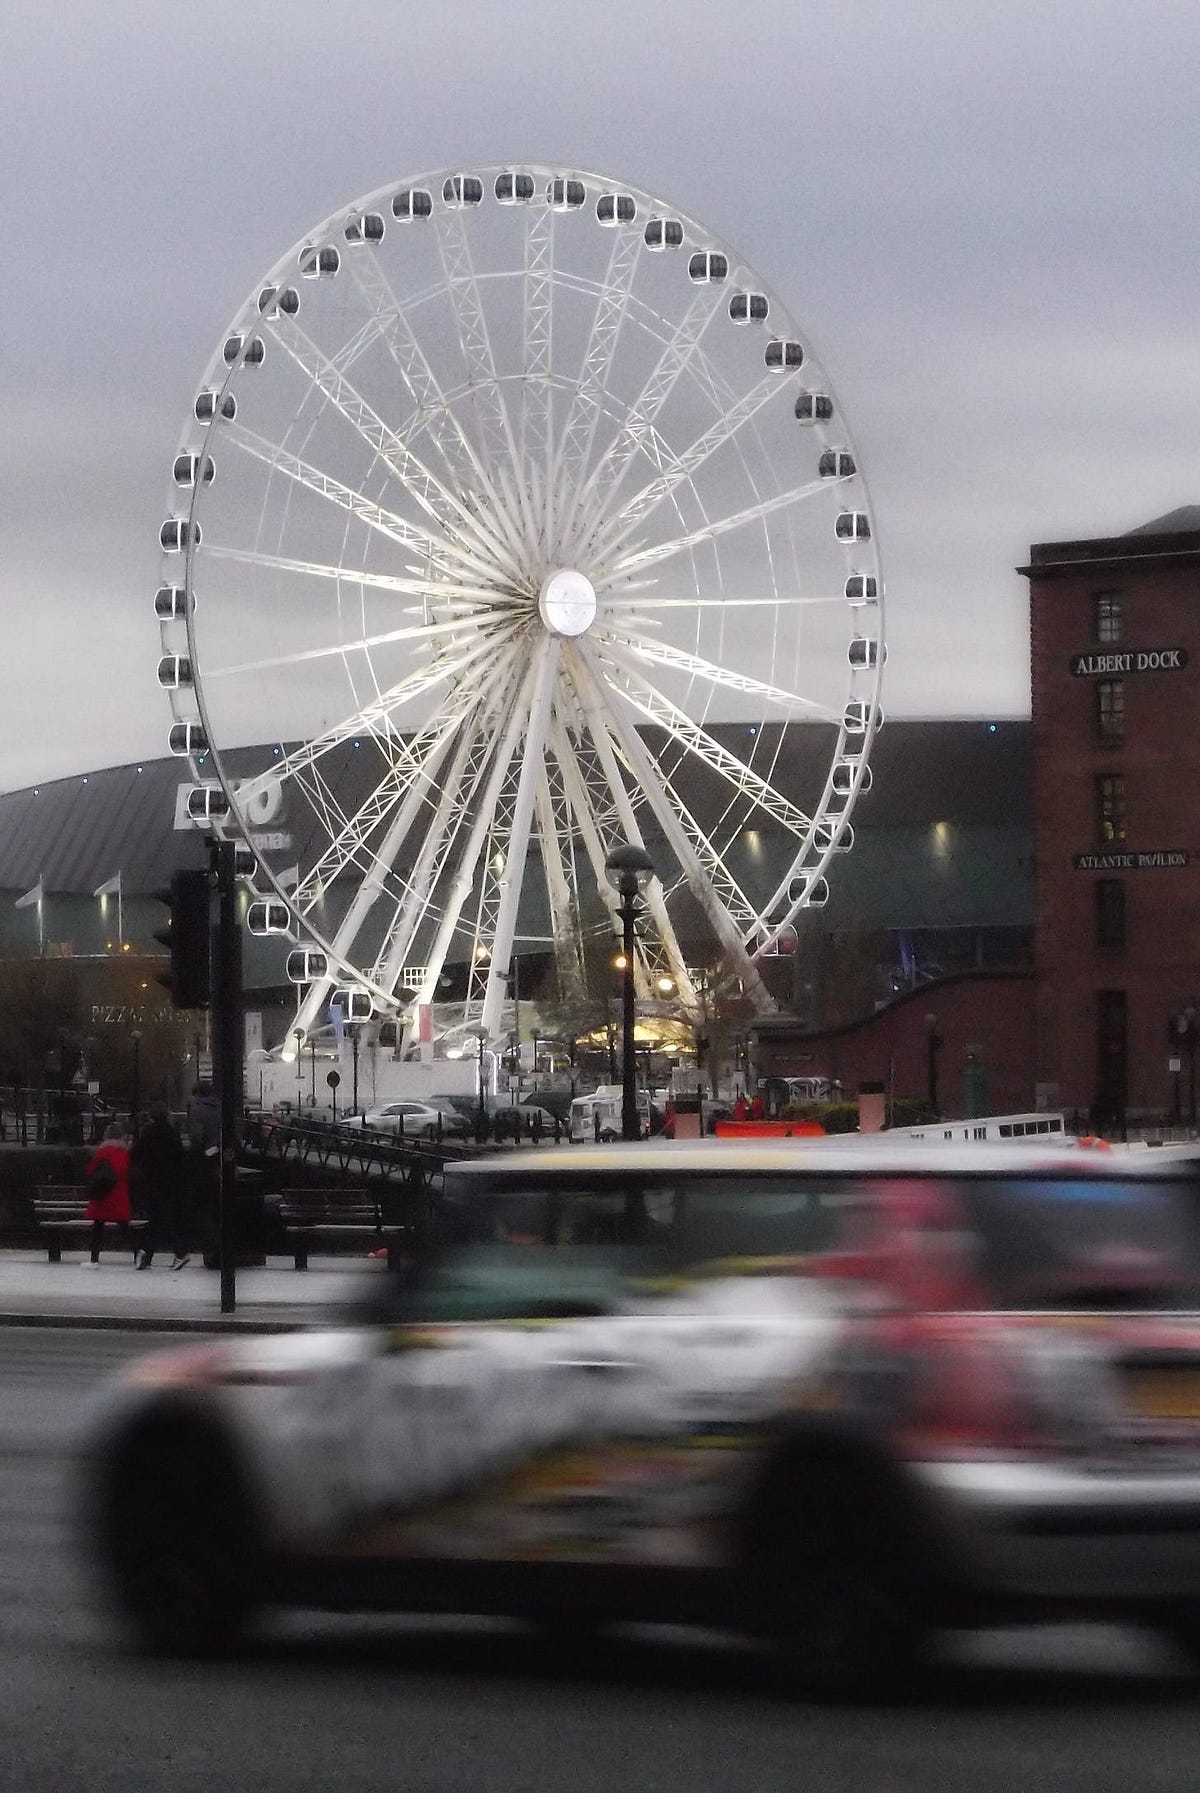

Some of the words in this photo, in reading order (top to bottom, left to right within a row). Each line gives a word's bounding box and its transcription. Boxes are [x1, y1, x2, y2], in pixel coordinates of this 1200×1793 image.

[1077, 654, 1133, 674] ALBERT
[1137, 651, 1181, 670] DOCK
[1079, 855, 1134, 869] ATLANTIC
[1137, 852, 1186, 866] PAVILION
